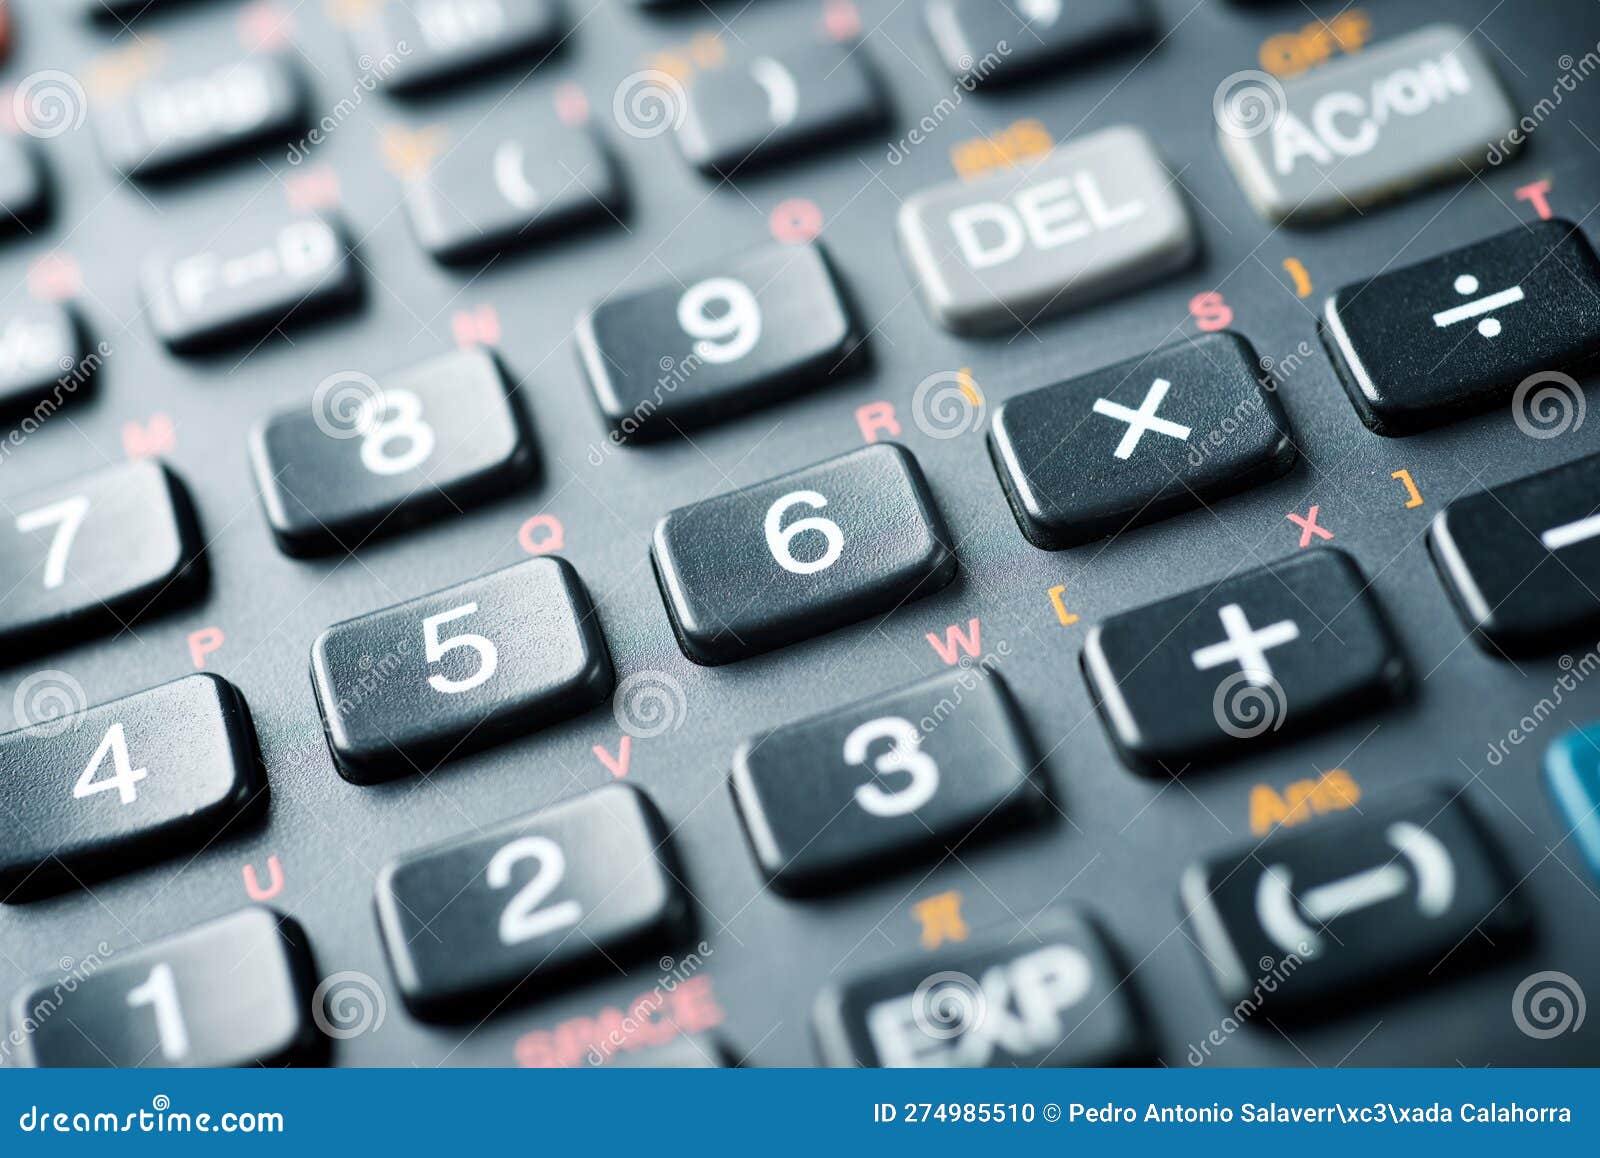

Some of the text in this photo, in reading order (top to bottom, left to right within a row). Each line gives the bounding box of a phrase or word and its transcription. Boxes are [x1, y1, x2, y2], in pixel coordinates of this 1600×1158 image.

[949, 170, 1146, 268] DEL
[1514, 179, 1553, 221] T
[677, 277, 762, 364] 9
[1188, 291, 1234, 332] S
[353, 389, 435, 476] 8
[854, 401, 902, 443] R
[16, 495, 90, 589] 7
[519, 514, 565, 555] Q
[763, 489, 845, 575] 6
[1286, 505, 1335, 548] X
[186, 627, 226, 669] P
[422, 601, 500, 695] 5
[925, 617, 982, 666] W
[72, 721, 148, 805] 4
[592, 734, 632, 778] V
[843, 716, 941, 816] 3
[1249, 768, 1361, 836] Ans
[242, 855, 285, 900] U
[487, 836, 581, 944] 2
[126, 962, 190, 1060] 1
[865, 943, 1092, 1068] EXP
